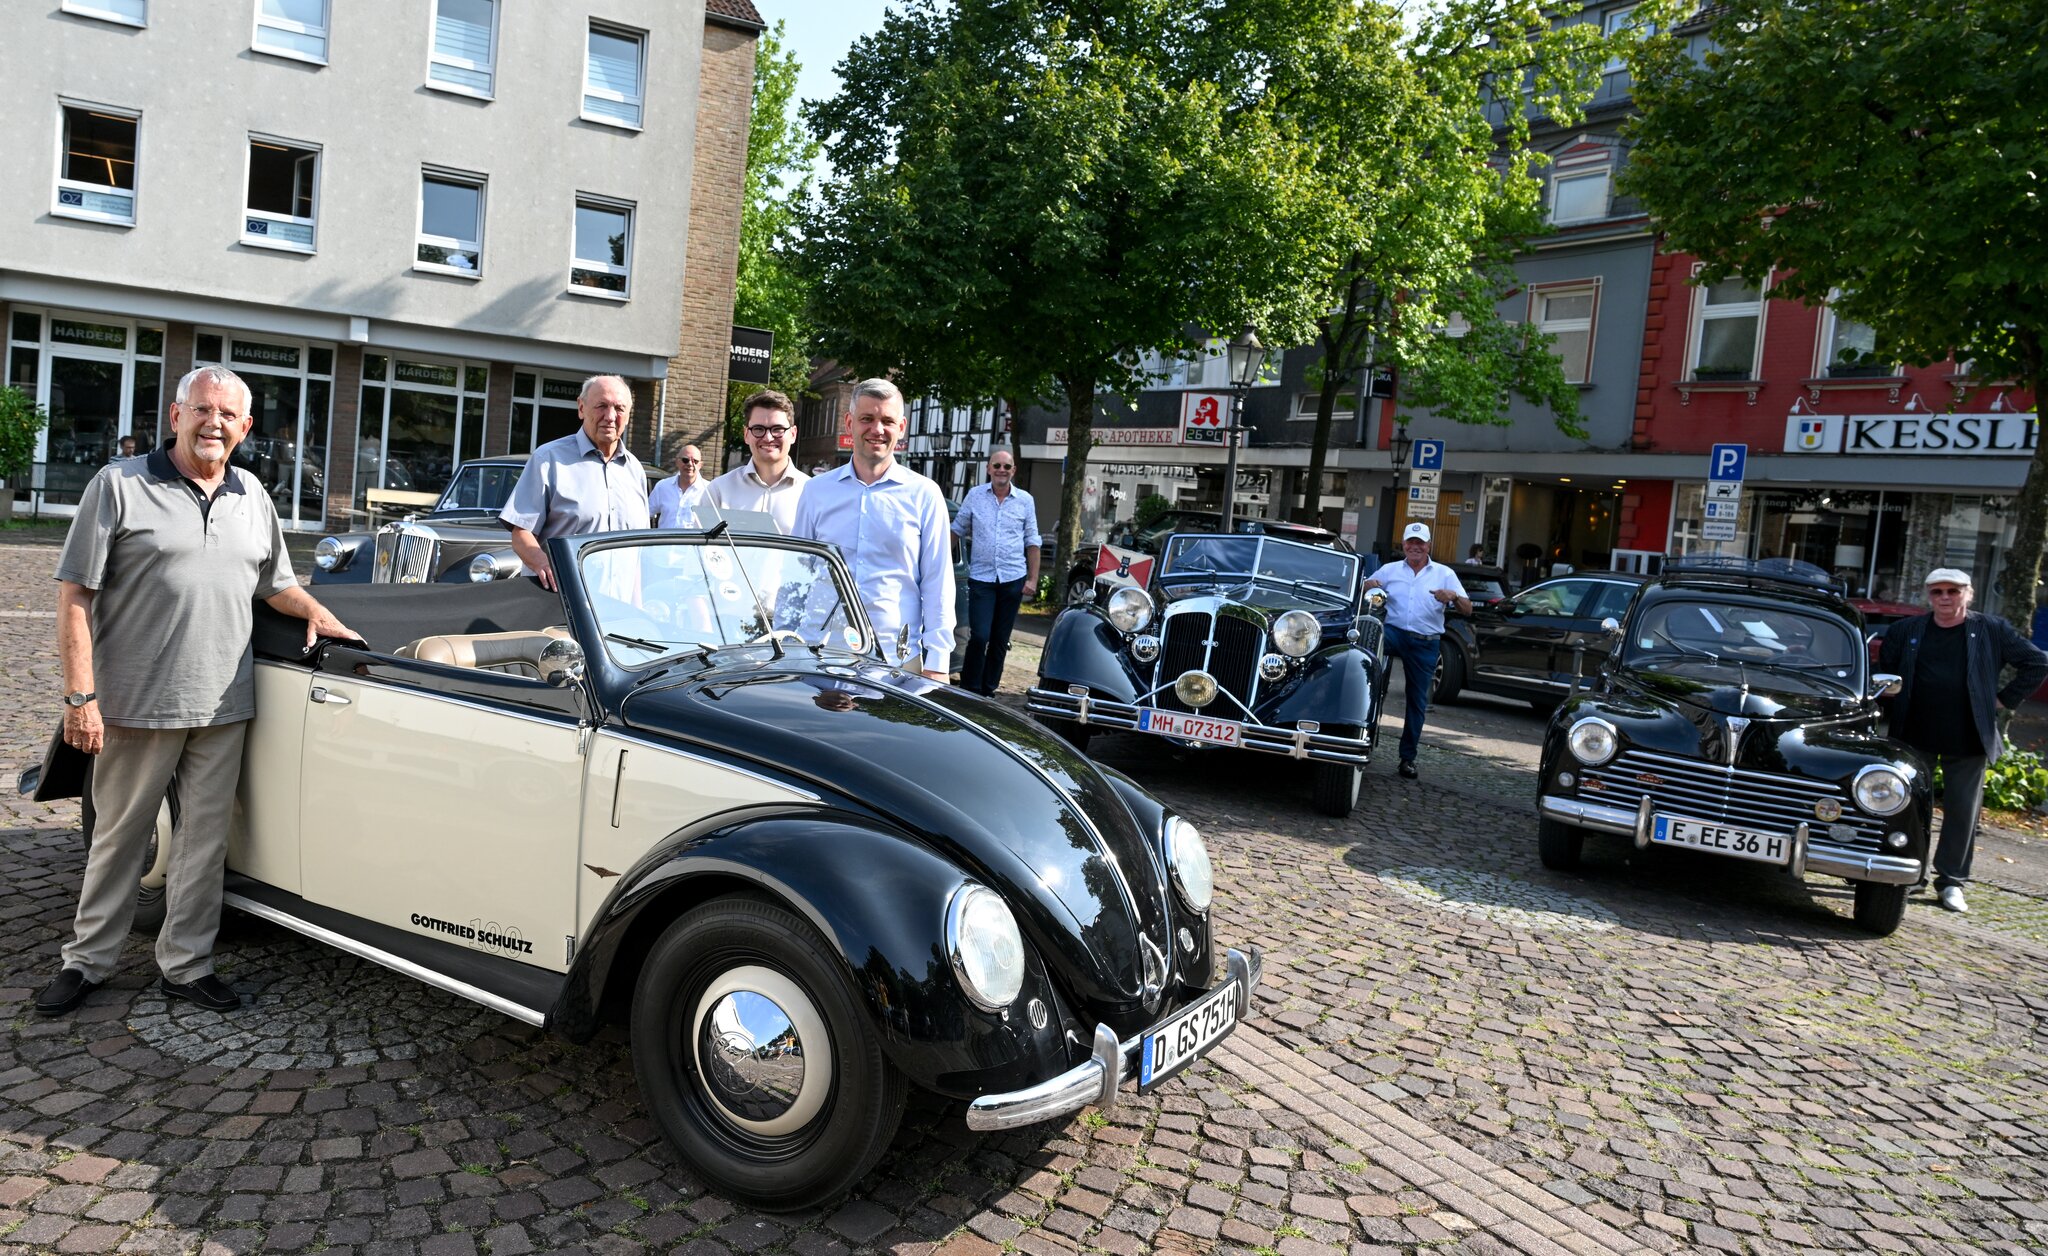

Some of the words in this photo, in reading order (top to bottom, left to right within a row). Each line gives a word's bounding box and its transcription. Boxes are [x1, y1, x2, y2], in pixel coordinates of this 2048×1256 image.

[61, 192, 81, 205] OZ
[248, 221, 266, 233] OZ
[55, 326, 123, 343] HARDERS
[234, 346, 296, 362] HARDERS
[730, 345, 769, 358] ARDERS
[731, 355, 762, 364] ASHION
[397, 367, 454, 381] HARDERS
[544, 384, 582, 396] HARDE
[1419, 443, 1437, 466] P
[1717, 449, 1738, 476] P
[1151, 714, 1174, 732] MH
[1183, 720, 1235, 742] 07312
[1671, 822, 1686, 842] E
[1700, 826, 1729, 849] EE
[1732, 832, 1760, 853] 36
[1766, 838, 1782, 858] H
[411, 913, 476, 939] GOTTFRIED
[477, 930, 533, 954] SCHULTZ
[1144, 1065, 1149, 1077] D
[1153, 1034, 1166, 1074] D
[1177, 1013, 1199, 1058] GS
[1203, 986, 1236, 1041] 751H
